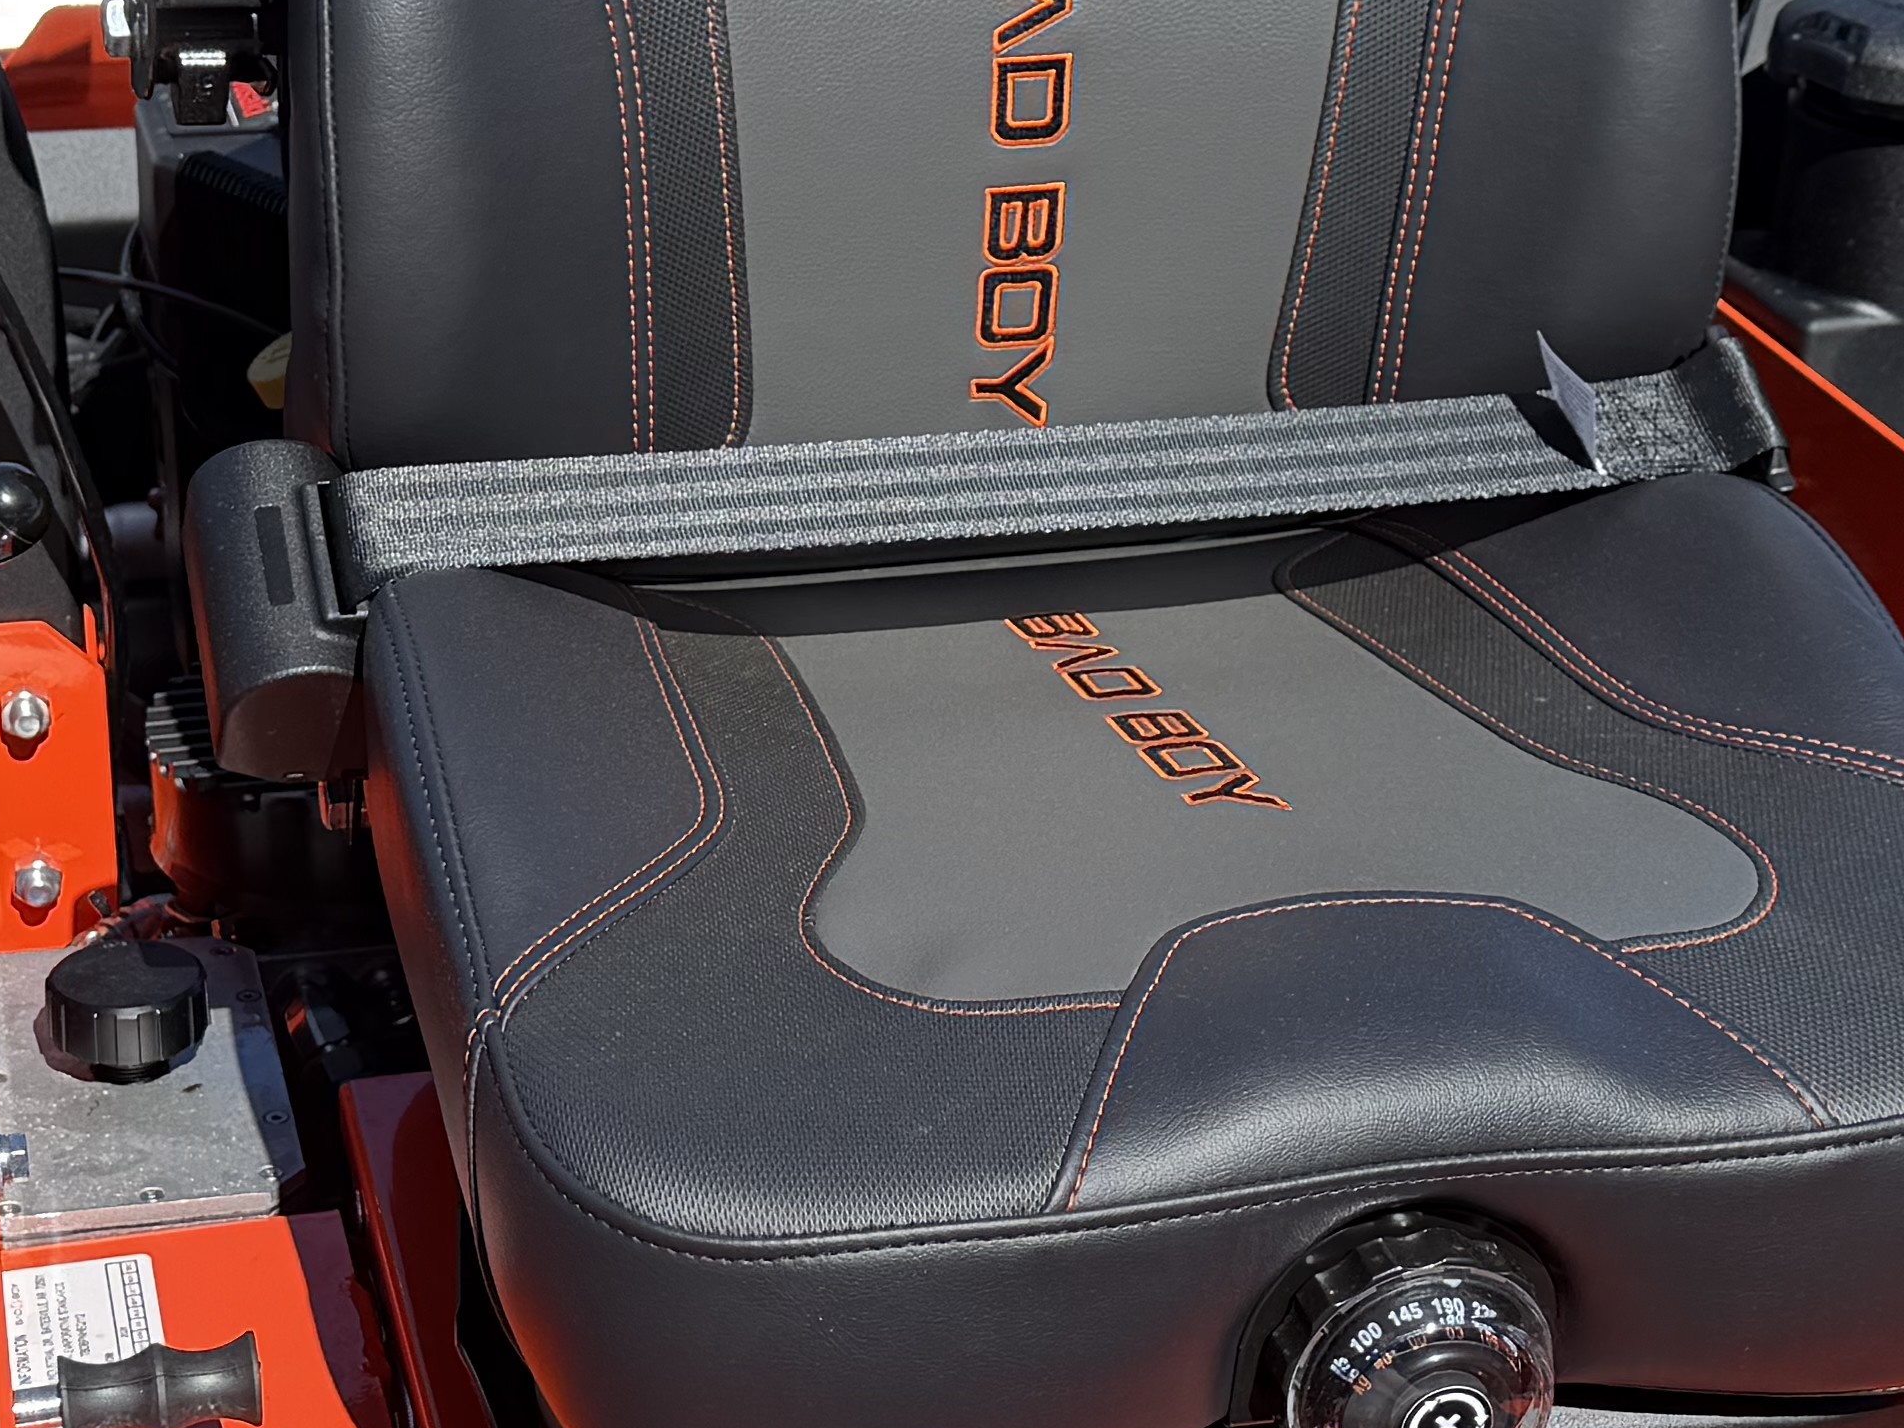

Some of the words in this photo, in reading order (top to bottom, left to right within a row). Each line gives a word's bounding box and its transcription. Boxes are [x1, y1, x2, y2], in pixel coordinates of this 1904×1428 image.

[970, 182, 1066, 427] BOY
[1004, 611, 1164, 701] BAD
[1105, 709, 1293, 811] BOY
[1350, 1322, 1382, 1353] 100
[1388, 1302, 1424, 1327] 145
